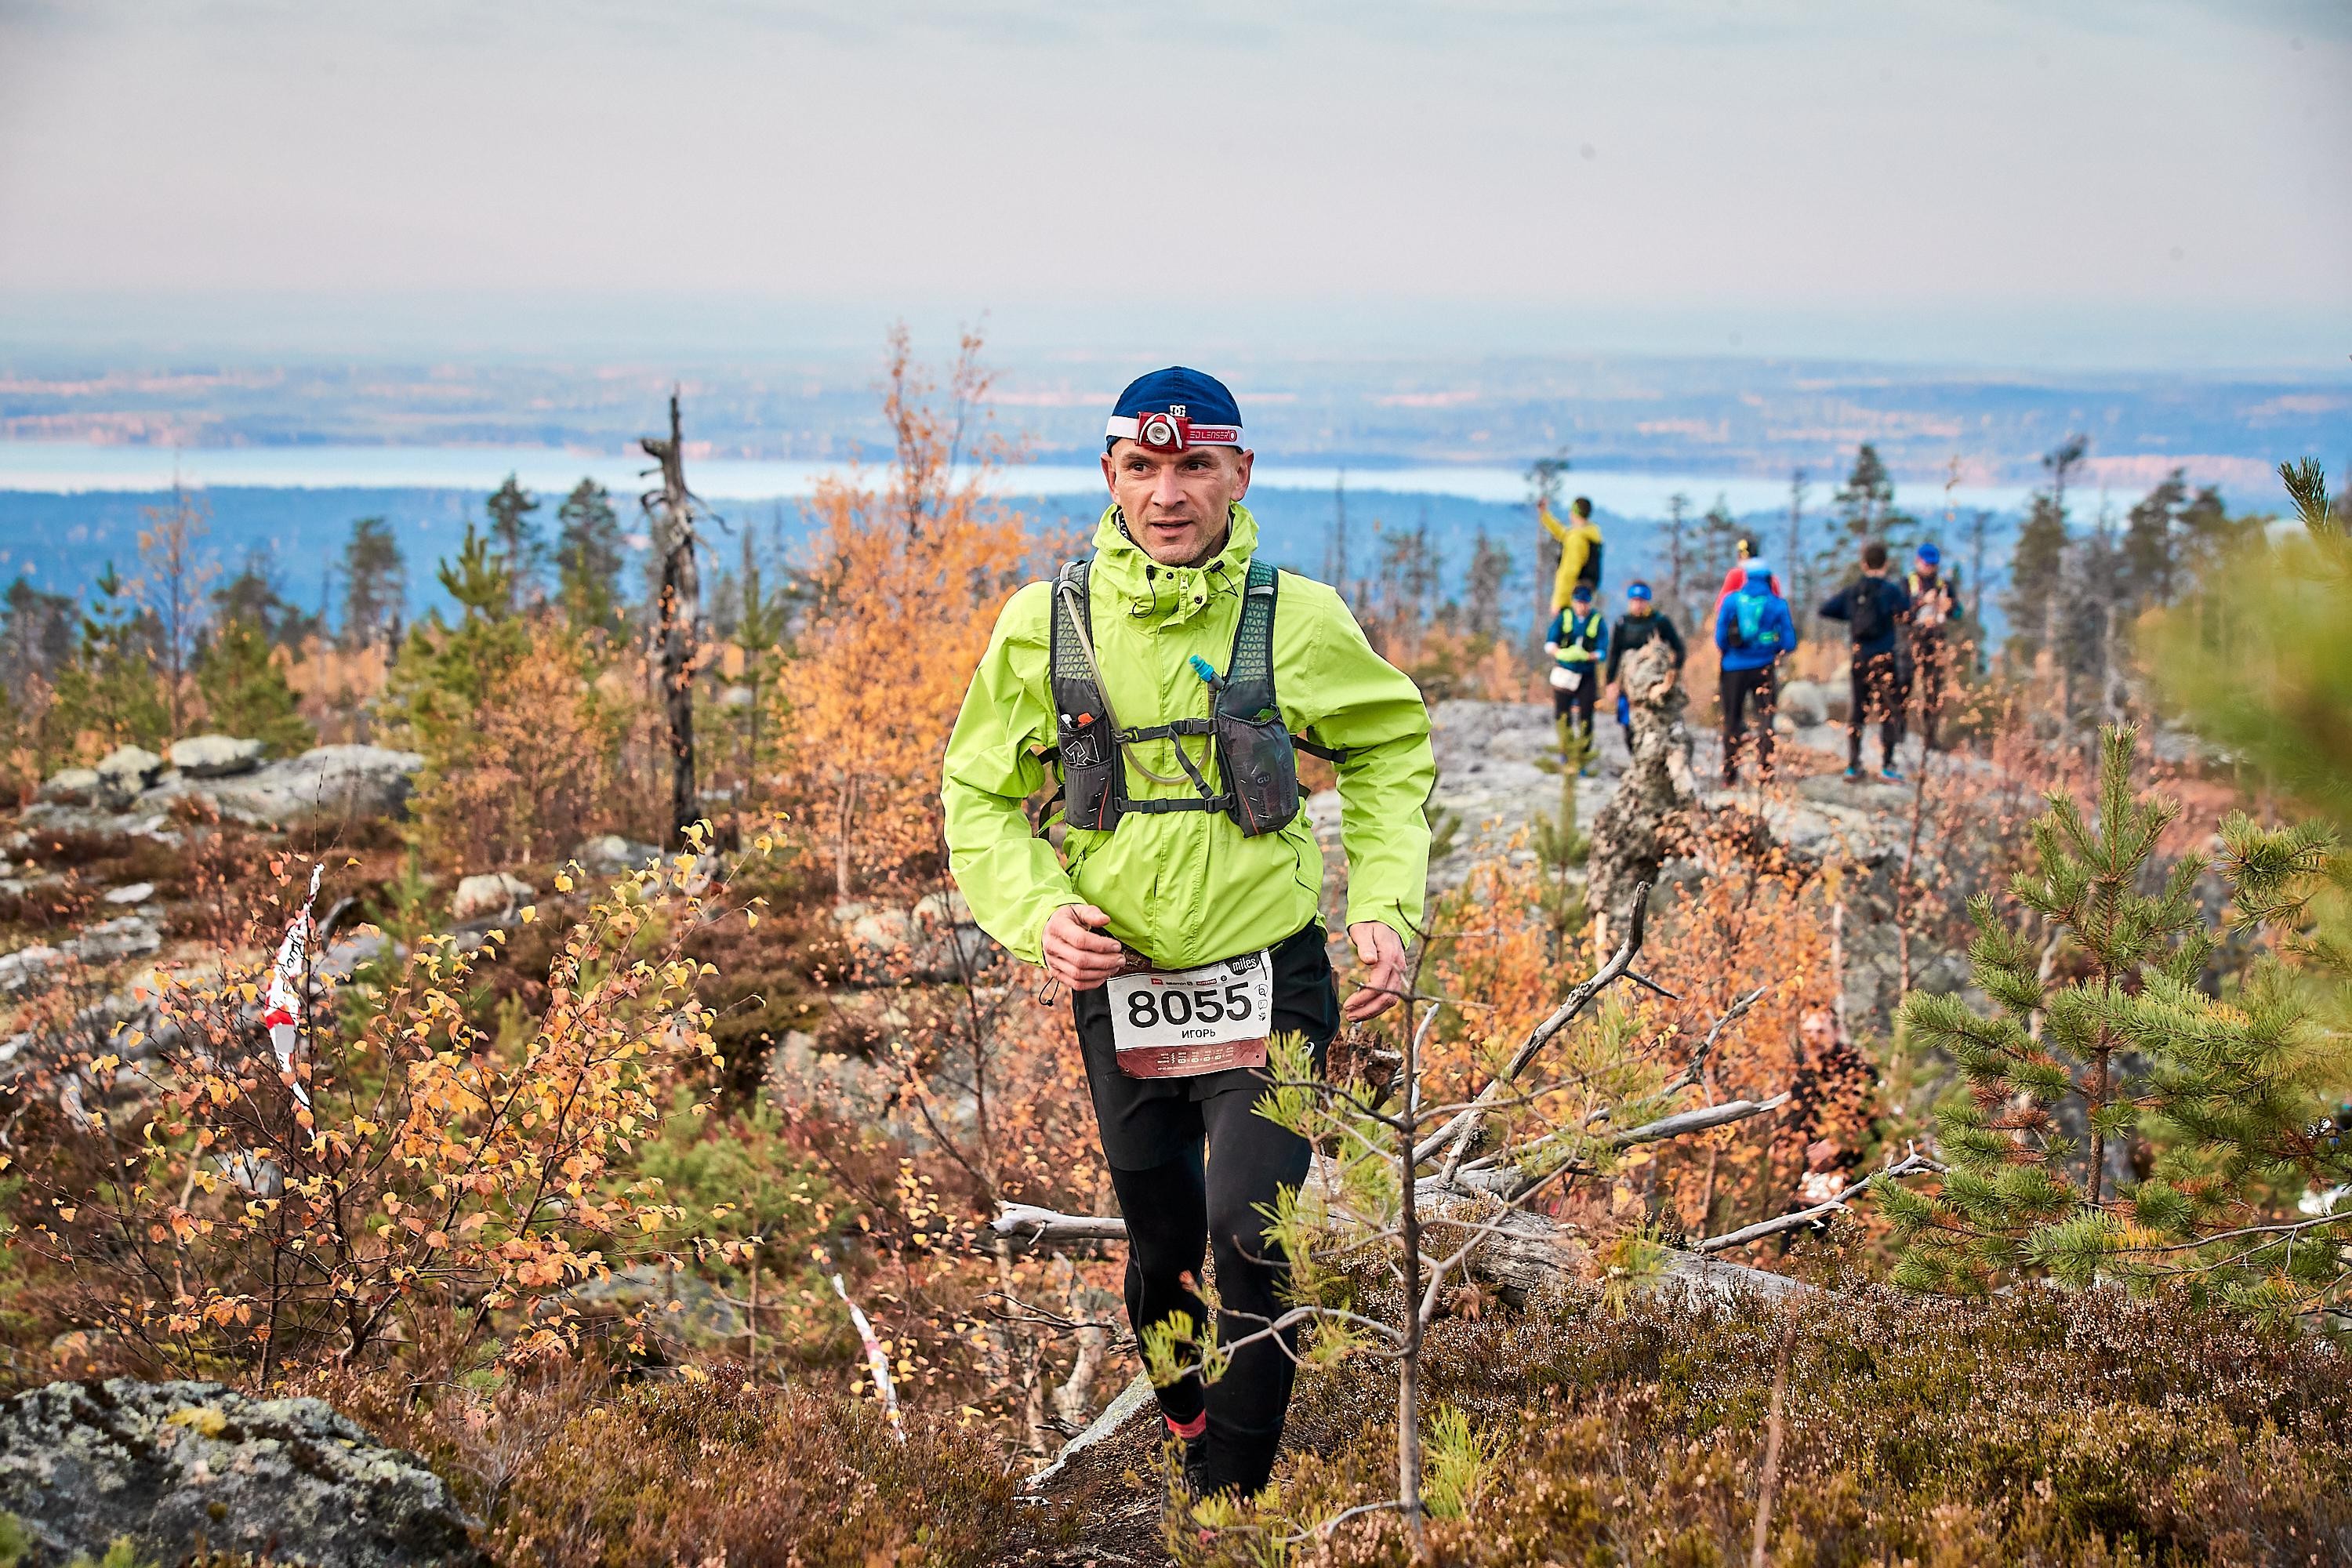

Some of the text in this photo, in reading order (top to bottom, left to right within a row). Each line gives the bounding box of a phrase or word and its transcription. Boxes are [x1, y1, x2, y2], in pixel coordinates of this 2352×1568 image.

[1257, 775, 1269, 784] GU
[1232, 957, 1257, 971] miles
[1127, 982, 1251, 1028] 8055
[1181, 1029, 1216, 1039] ИГОРЬ
